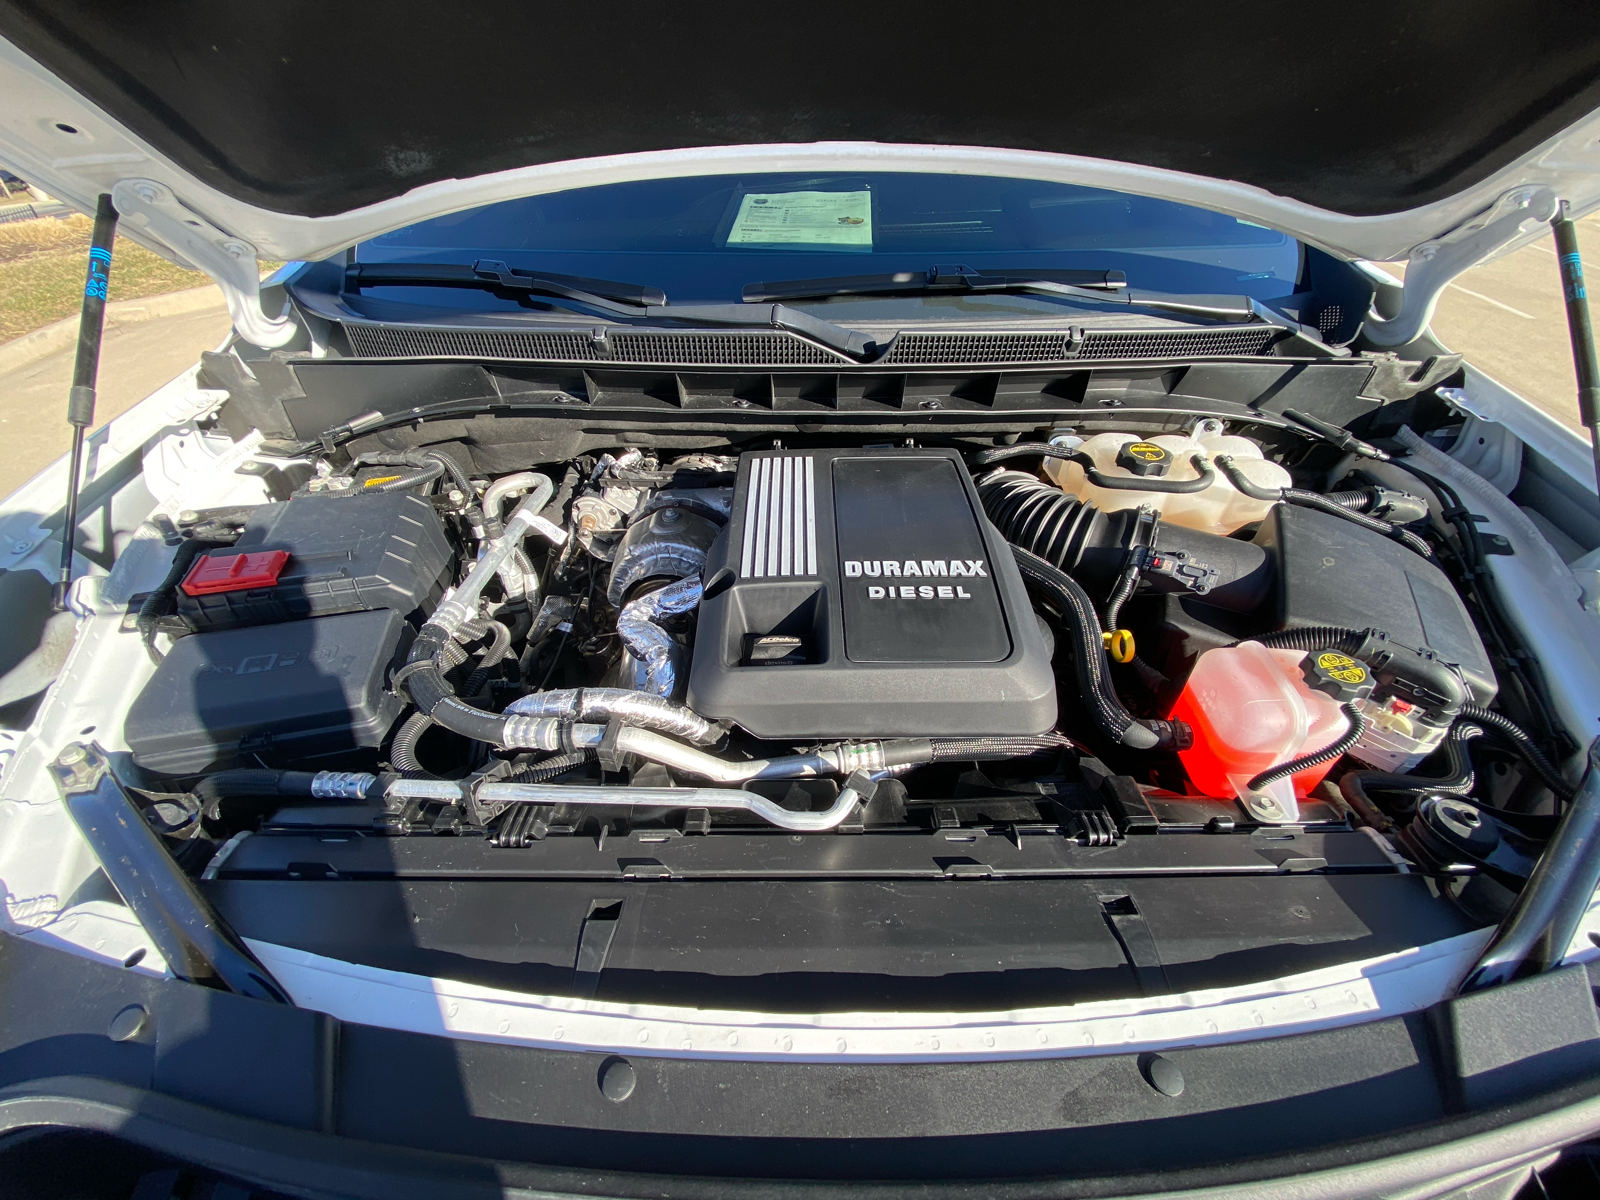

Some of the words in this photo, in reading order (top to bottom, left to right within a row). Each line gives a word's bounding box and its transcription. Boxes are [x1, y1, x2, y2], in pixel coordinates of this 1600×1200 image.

[844, 560, 988, 578] DURAMAX
[868, 586, 971, 600] DIESEL
[757, 636, 800, 645] ACDelco
